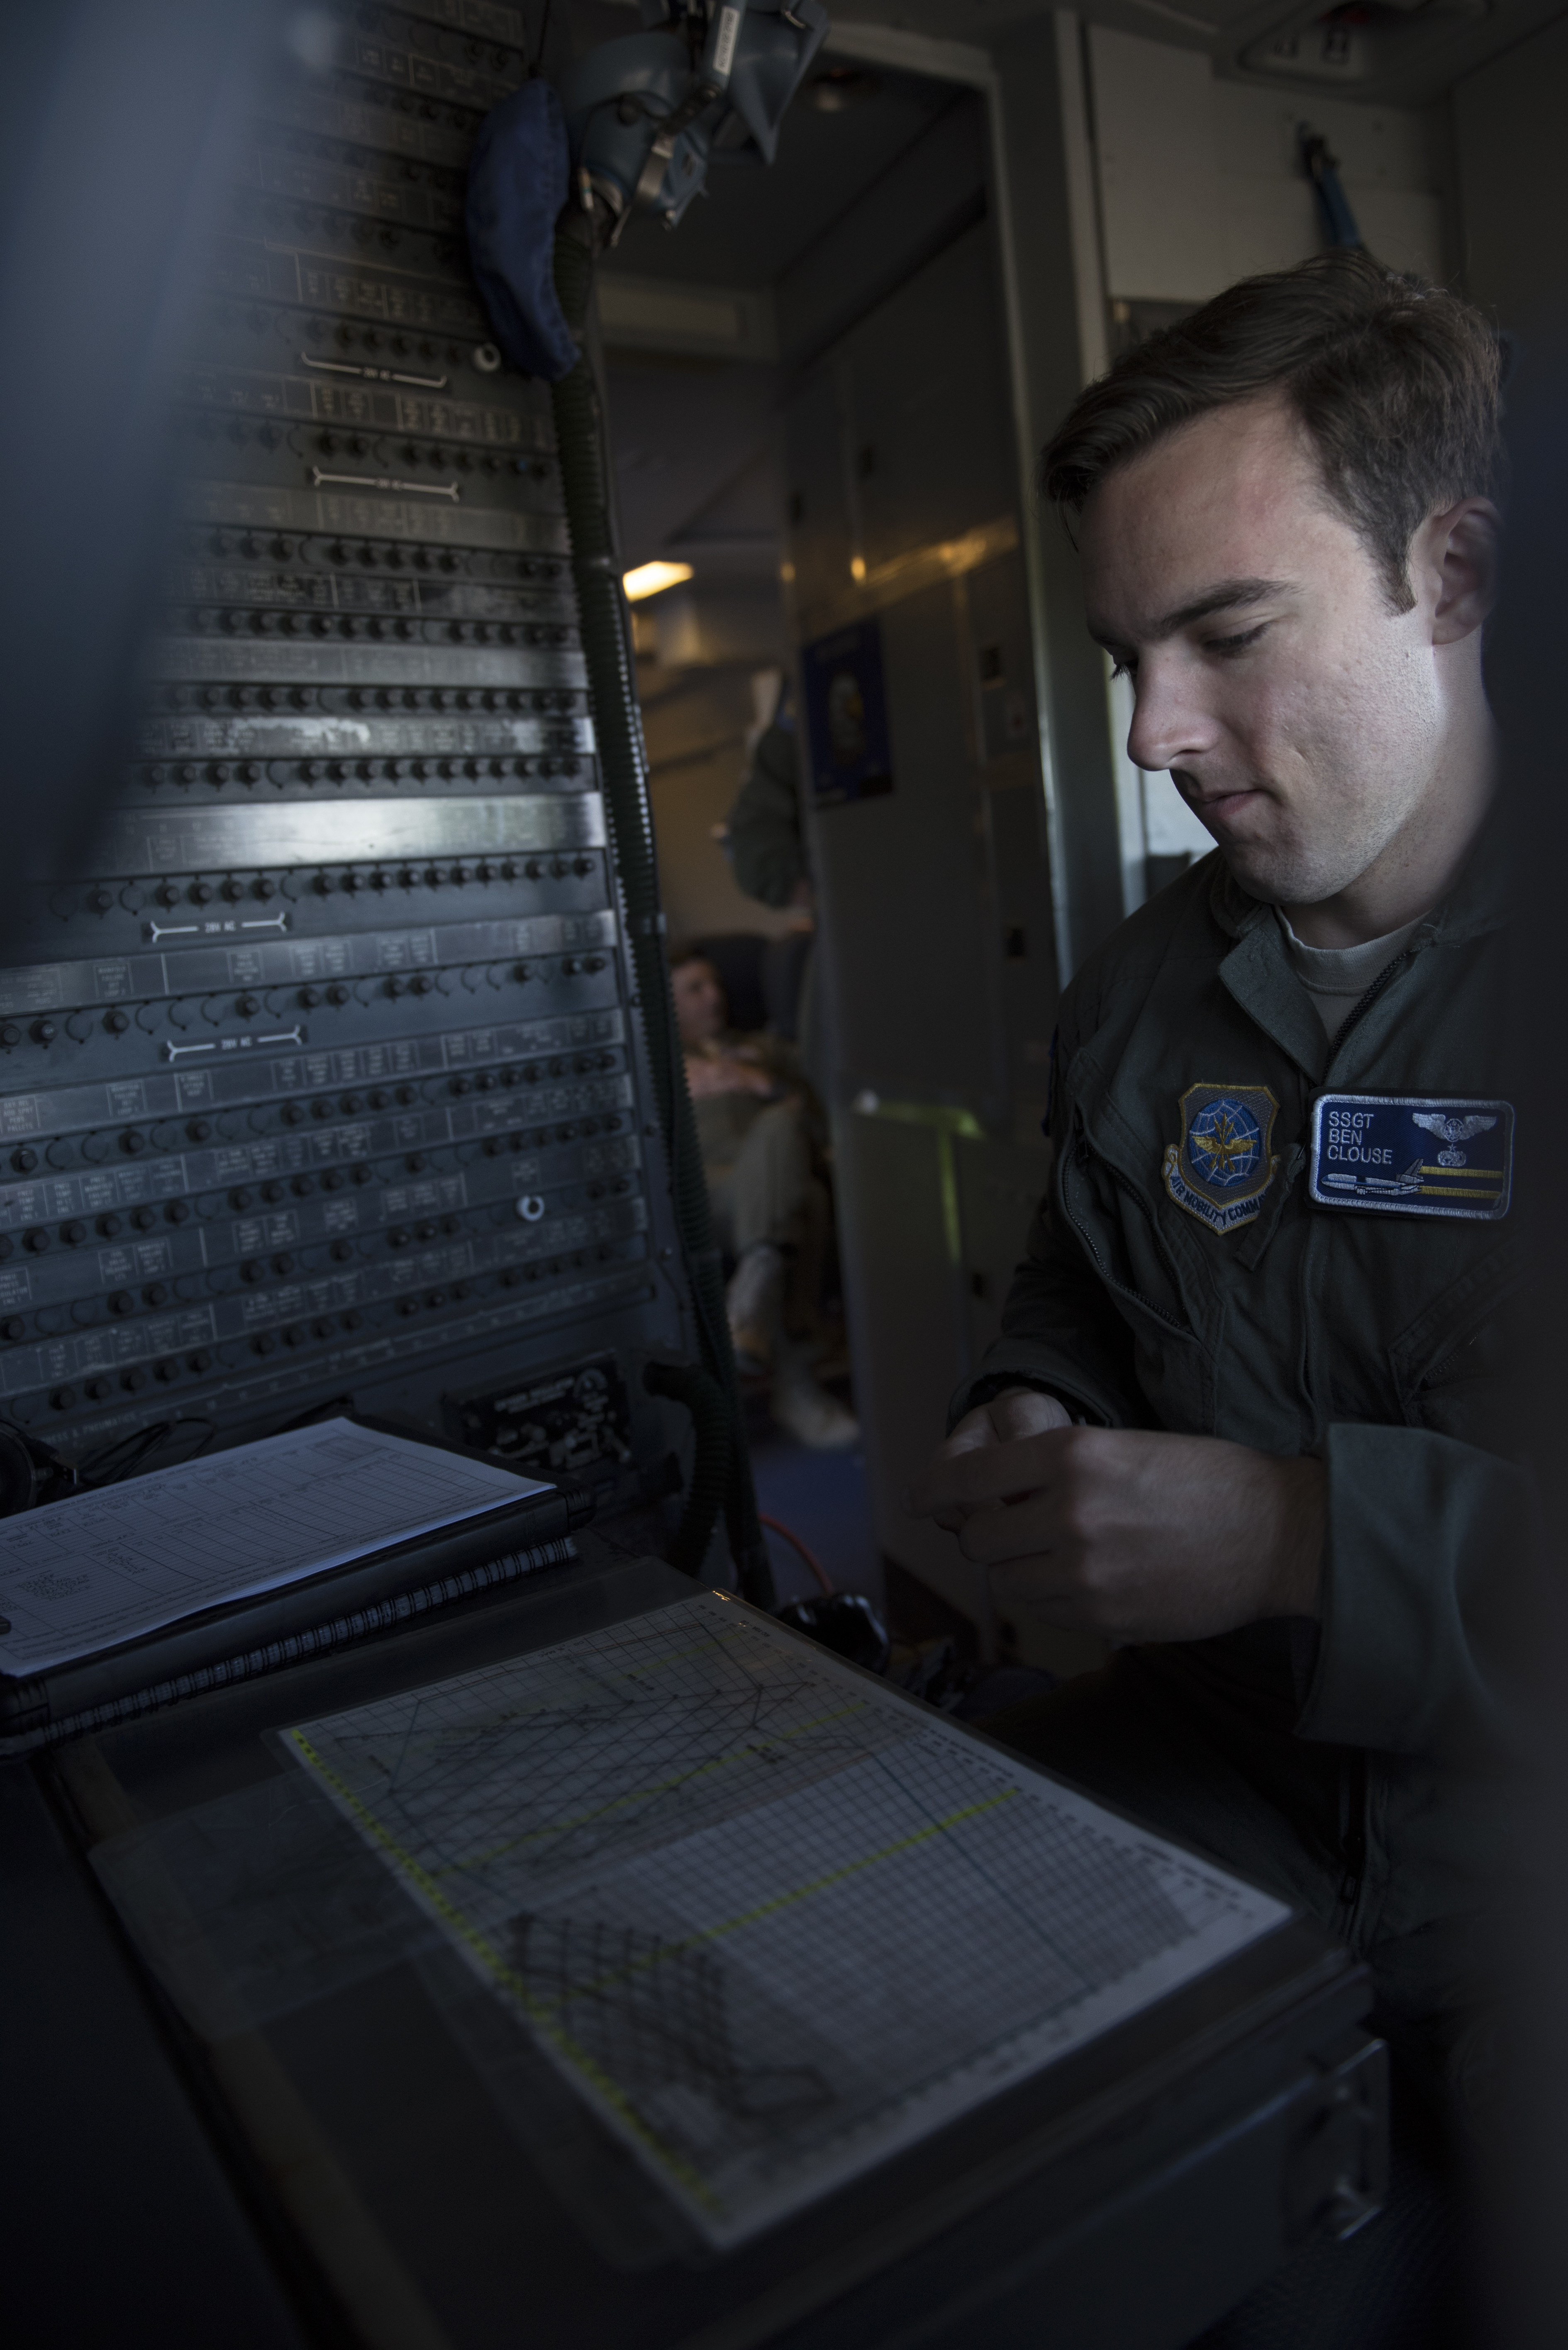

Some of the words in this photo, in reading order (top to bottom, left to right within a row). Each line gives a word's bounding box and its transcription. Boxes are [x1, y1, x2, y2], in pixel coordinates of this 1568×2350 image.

[1328, 1111, 1374, 1129] SSGT
[1328, 1128, 1362, 1146] BEN
[1327, 1145, 1392, 1165] CLOUSE
[1170, 1176, 1185, 1197] AIR
[1184, 1191, 1227, 1226] MOBILITY
